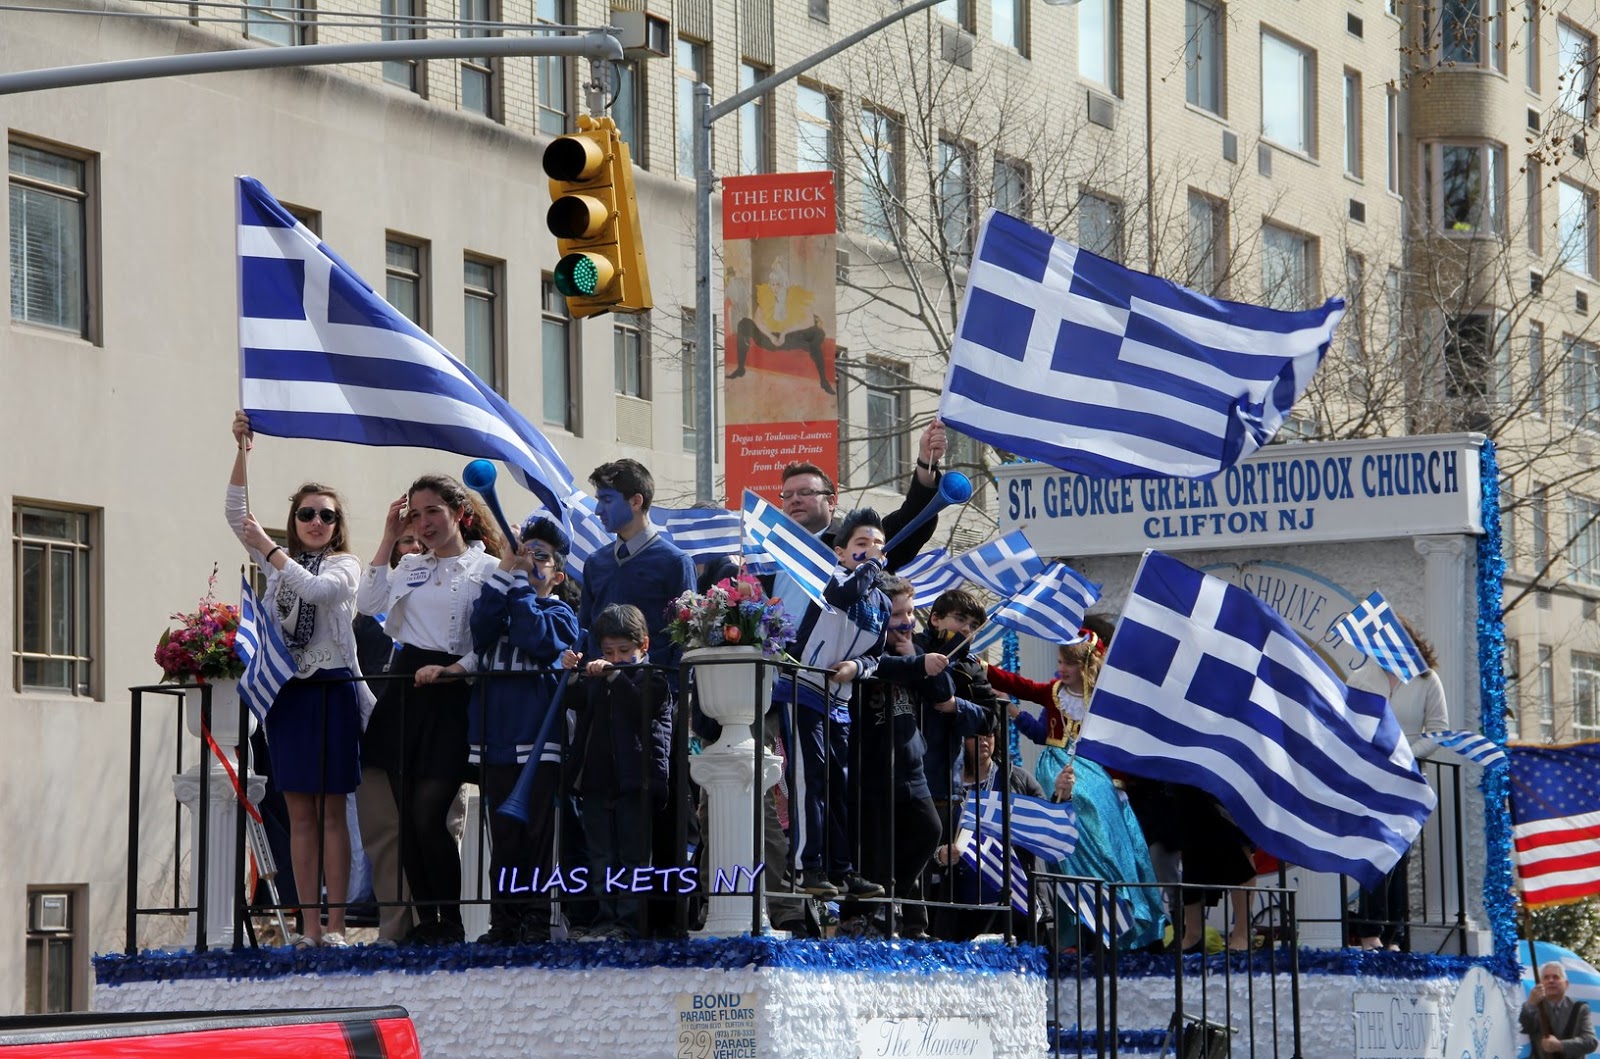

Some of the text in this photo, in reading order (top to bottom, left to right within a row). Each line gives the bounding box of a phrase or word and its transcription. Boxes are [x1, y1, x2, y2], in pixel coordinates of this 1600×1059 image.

[731, 186, 826, 206] THE FRICK
[731, 207, 827, 223] COLLECTION
[732, 431, 832, 445] Degas to Toulouse-Lautrec:
[740, 444, 823, 458] Drawings and Prints
[751, 461, 772, 475] from
[774, 461, 787, 470] the
[1008, 450, 1459, 521] ST. GEORGE GREEK ORTHODOX CHURCH
[1143, 507, 1315, 539] CLIFTON NJ
[1243, 573, 1327, 631] SHRINE
[693, 993, 741, 1009] BOND
[680, 1008, 755, 1022] PARADE FLOATS
[1356, 997, 1439, 1051] THE GROVE
[677, 1030, 712, 1059] 29
[715, 1038, 757, 1050] PARADE
[877, 1019, 979, 1057] The Hanover
[713, 1048, 757, 1059] VEHICLE
